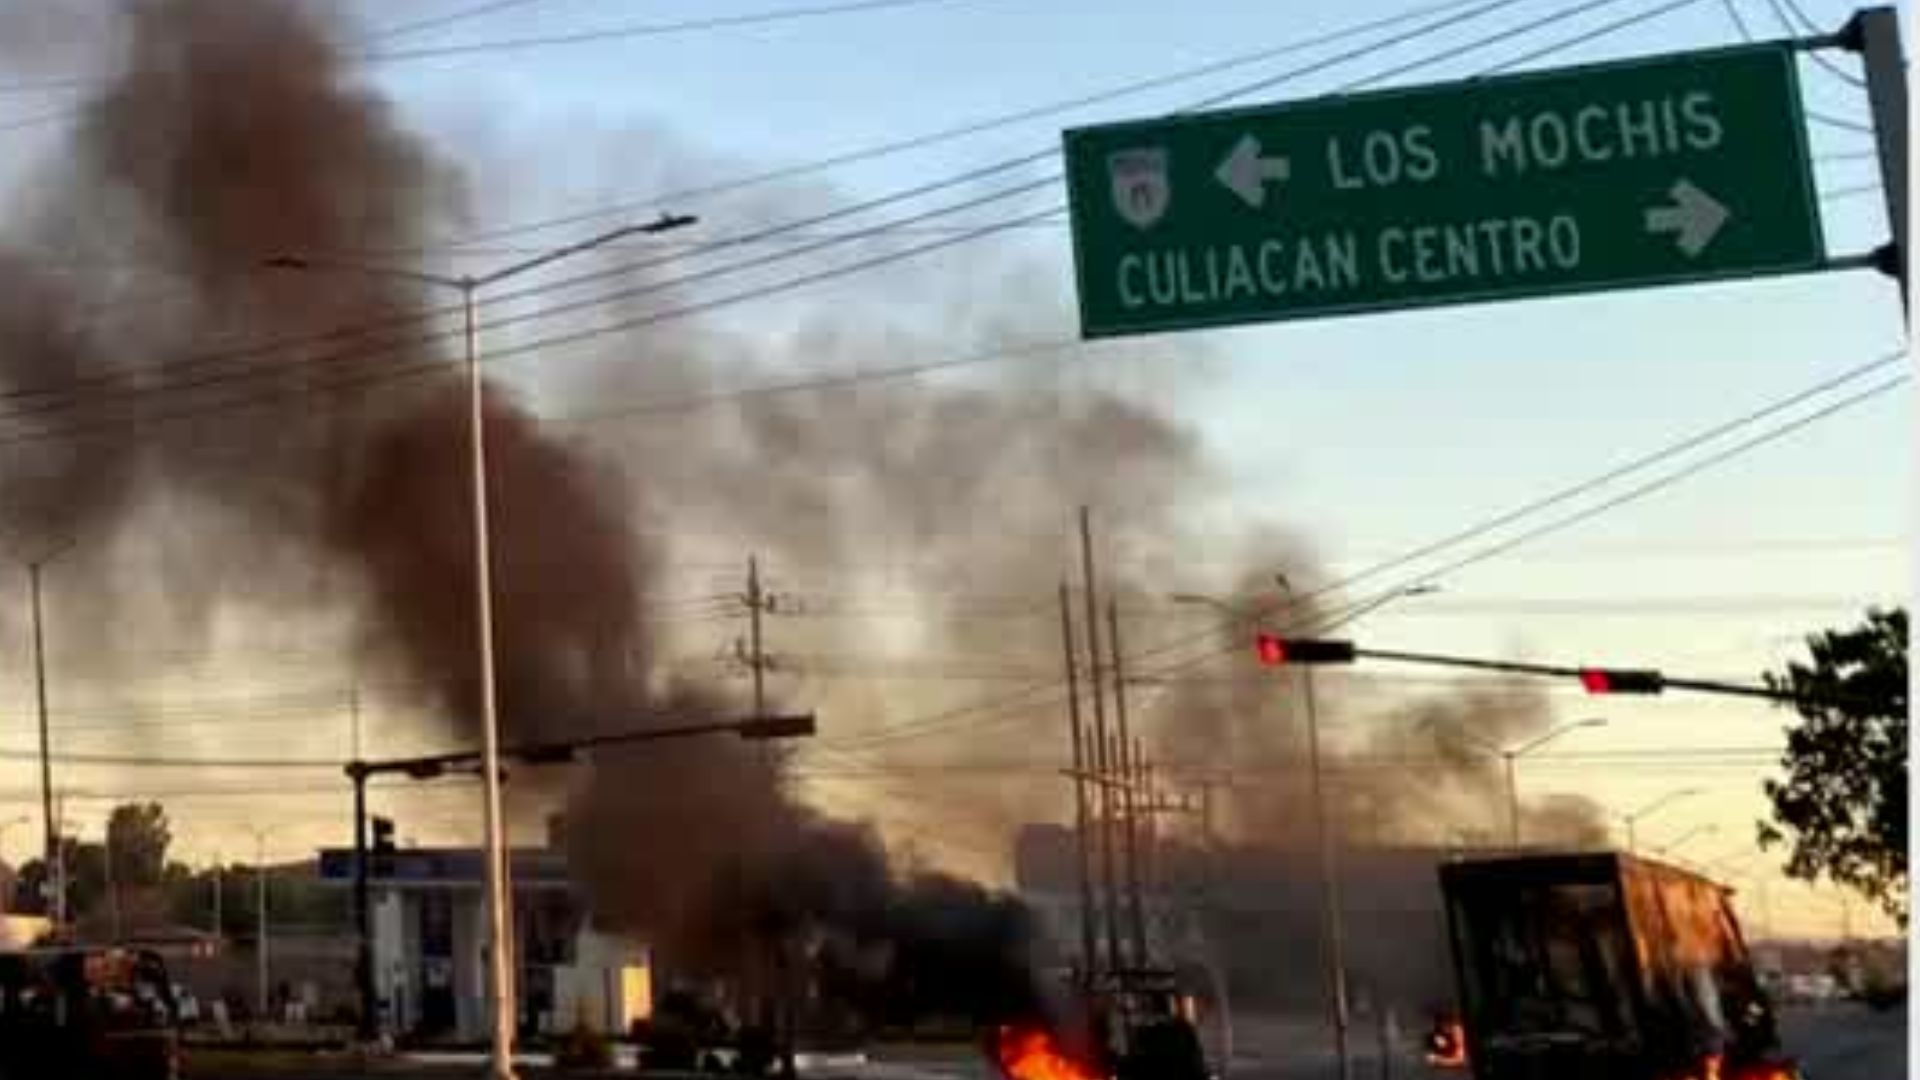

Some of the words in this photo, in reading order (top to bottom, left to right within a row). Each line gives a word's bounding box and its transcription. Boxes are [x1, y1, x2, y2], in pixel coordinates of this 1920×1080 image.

[1329, 128, 1438, 190] LOS
[1481, 92, 1723, 176] MOCHIS
[1117, 232, 1360, 306] CULIACAN
[1379, 215, 1582, 283] CENTRO
